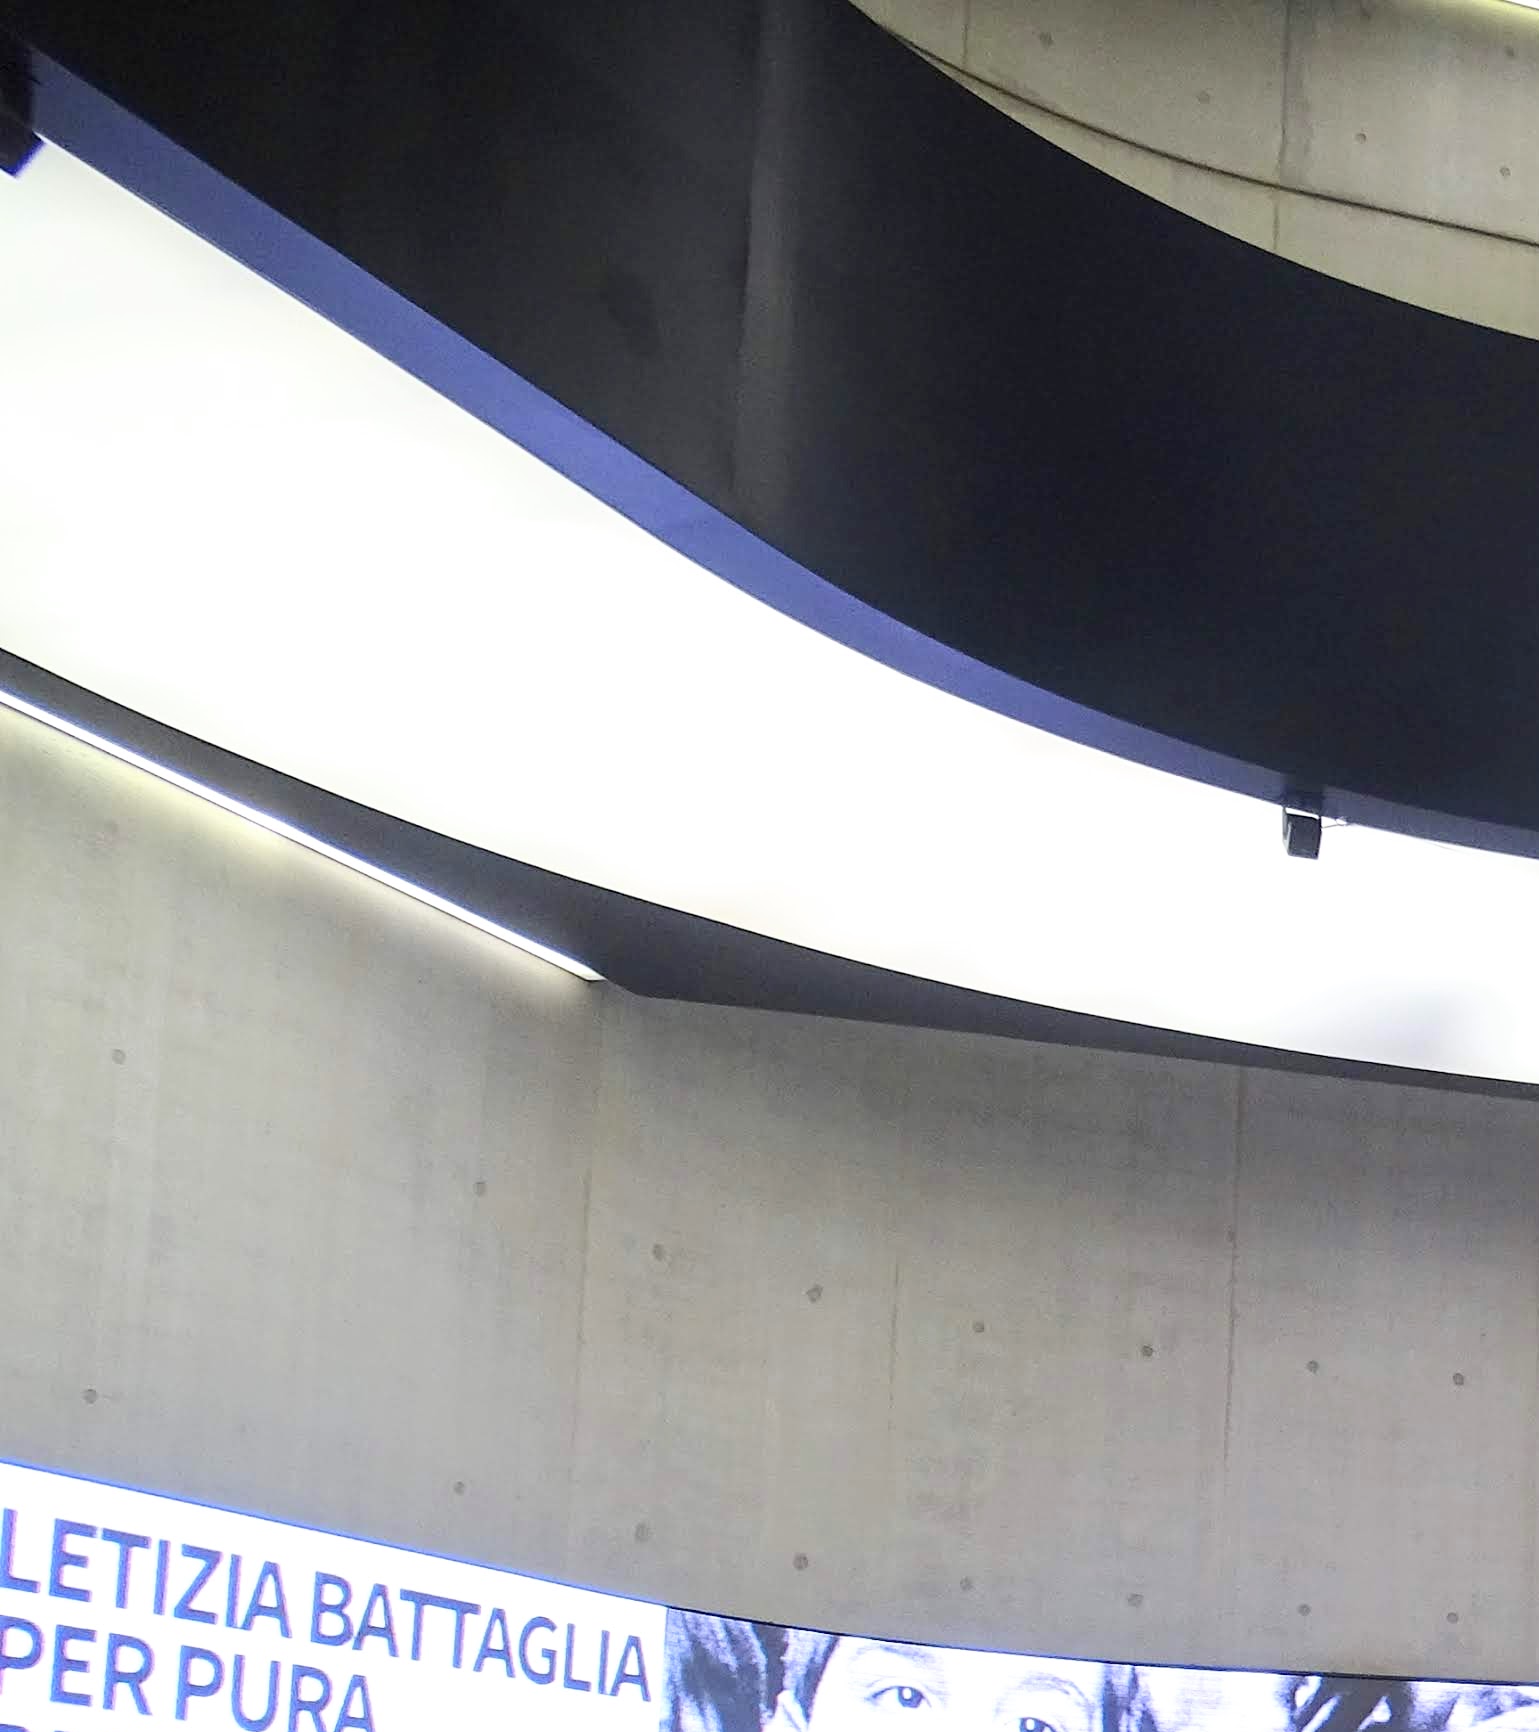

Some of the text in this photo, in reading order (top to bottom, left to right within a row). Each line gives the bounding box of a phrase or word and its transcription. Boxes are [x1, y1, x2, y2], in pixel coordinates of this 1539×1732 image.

[0, 1508, 651, 1702] LETIZIA BATTAGLIA
[0, 1614, 154, 1716] PER
